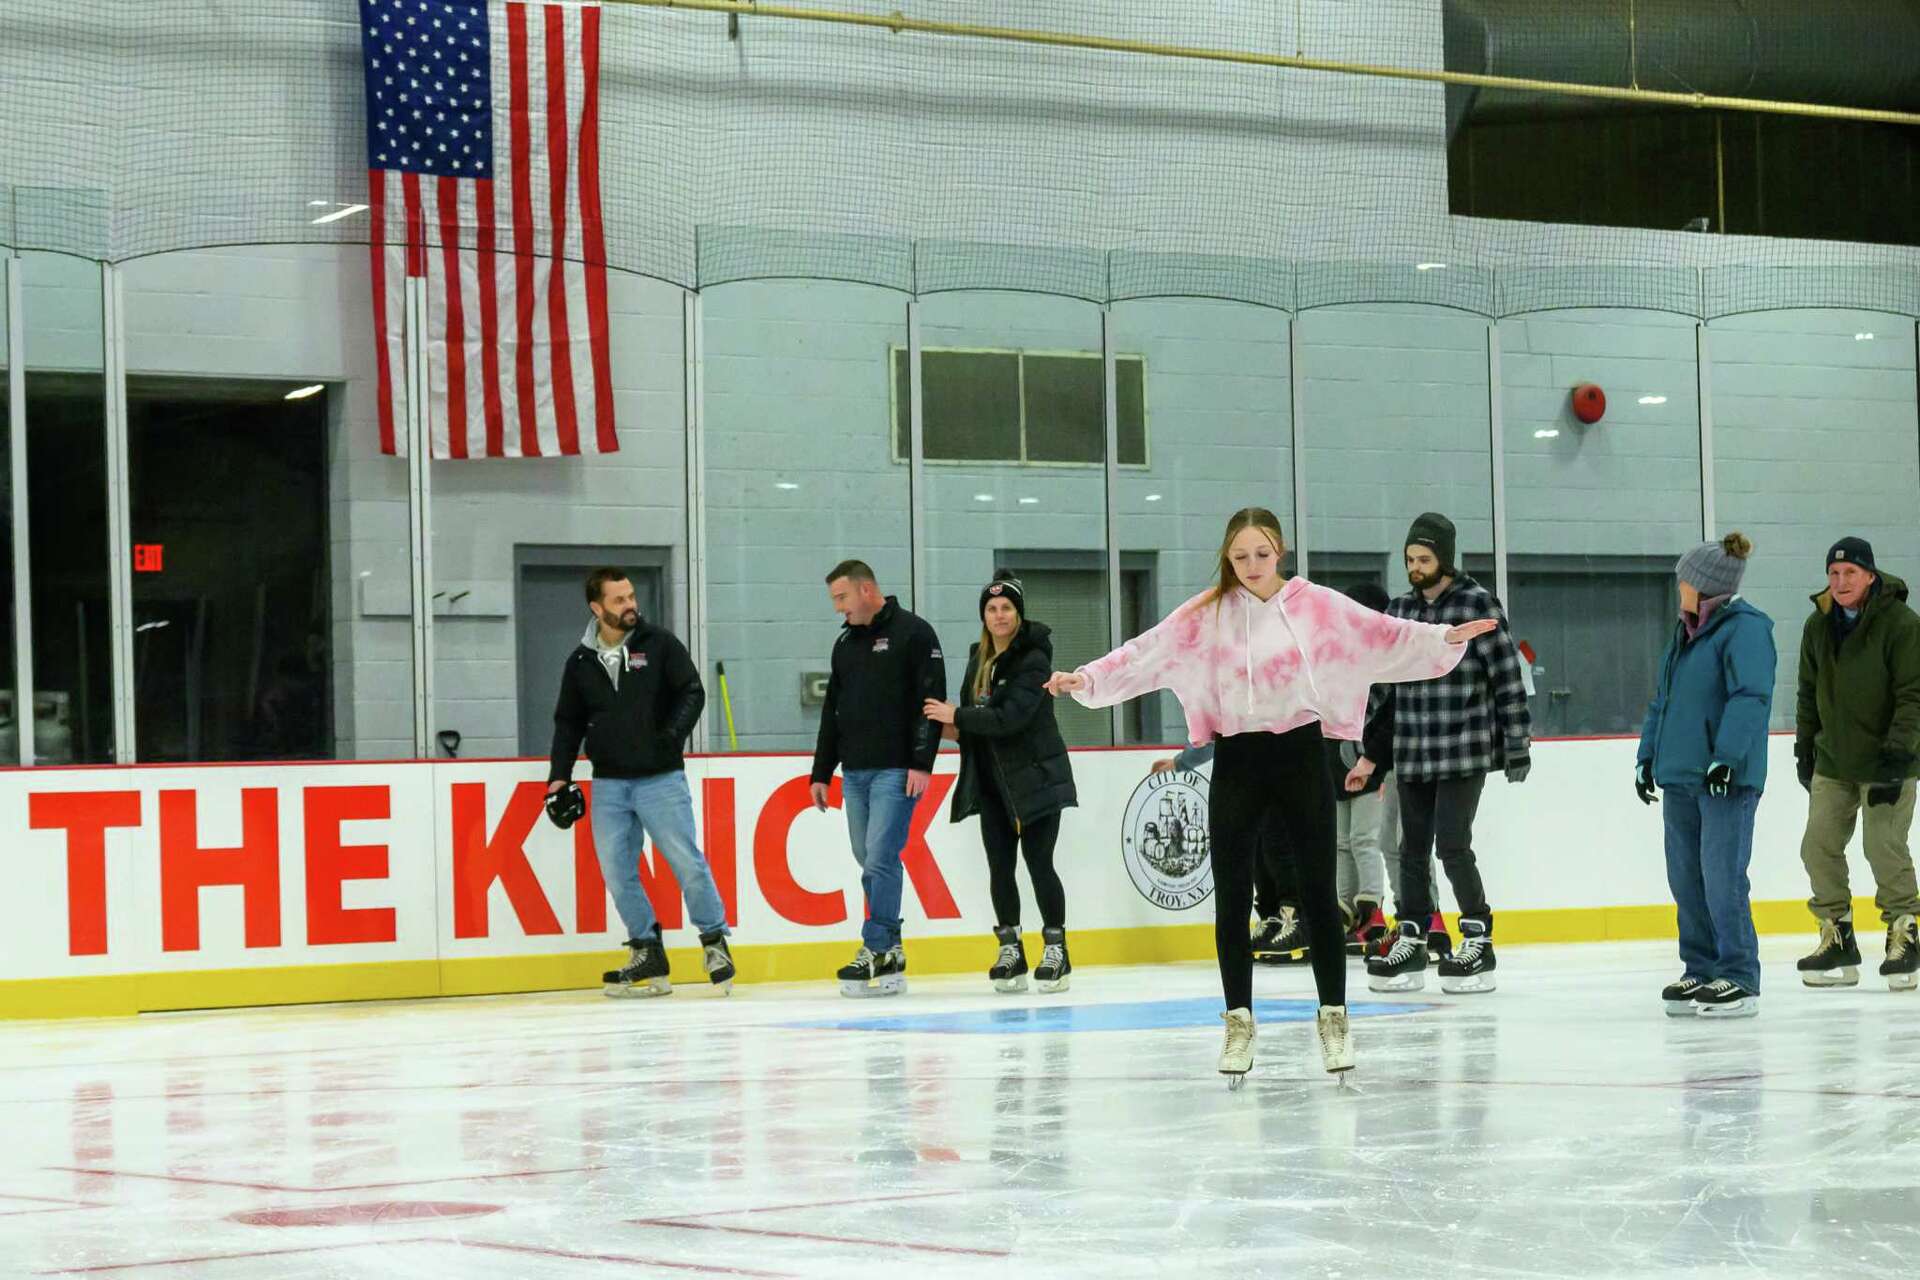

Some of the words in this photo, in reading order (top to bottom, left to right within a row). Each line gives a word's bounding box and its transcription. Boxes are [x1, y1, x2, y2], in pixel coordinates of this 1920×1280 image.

[1148, 769, 1177, 790] CITY
[1183, 770, 1202, 787] OF
[29, 784, 396, 956] THE
